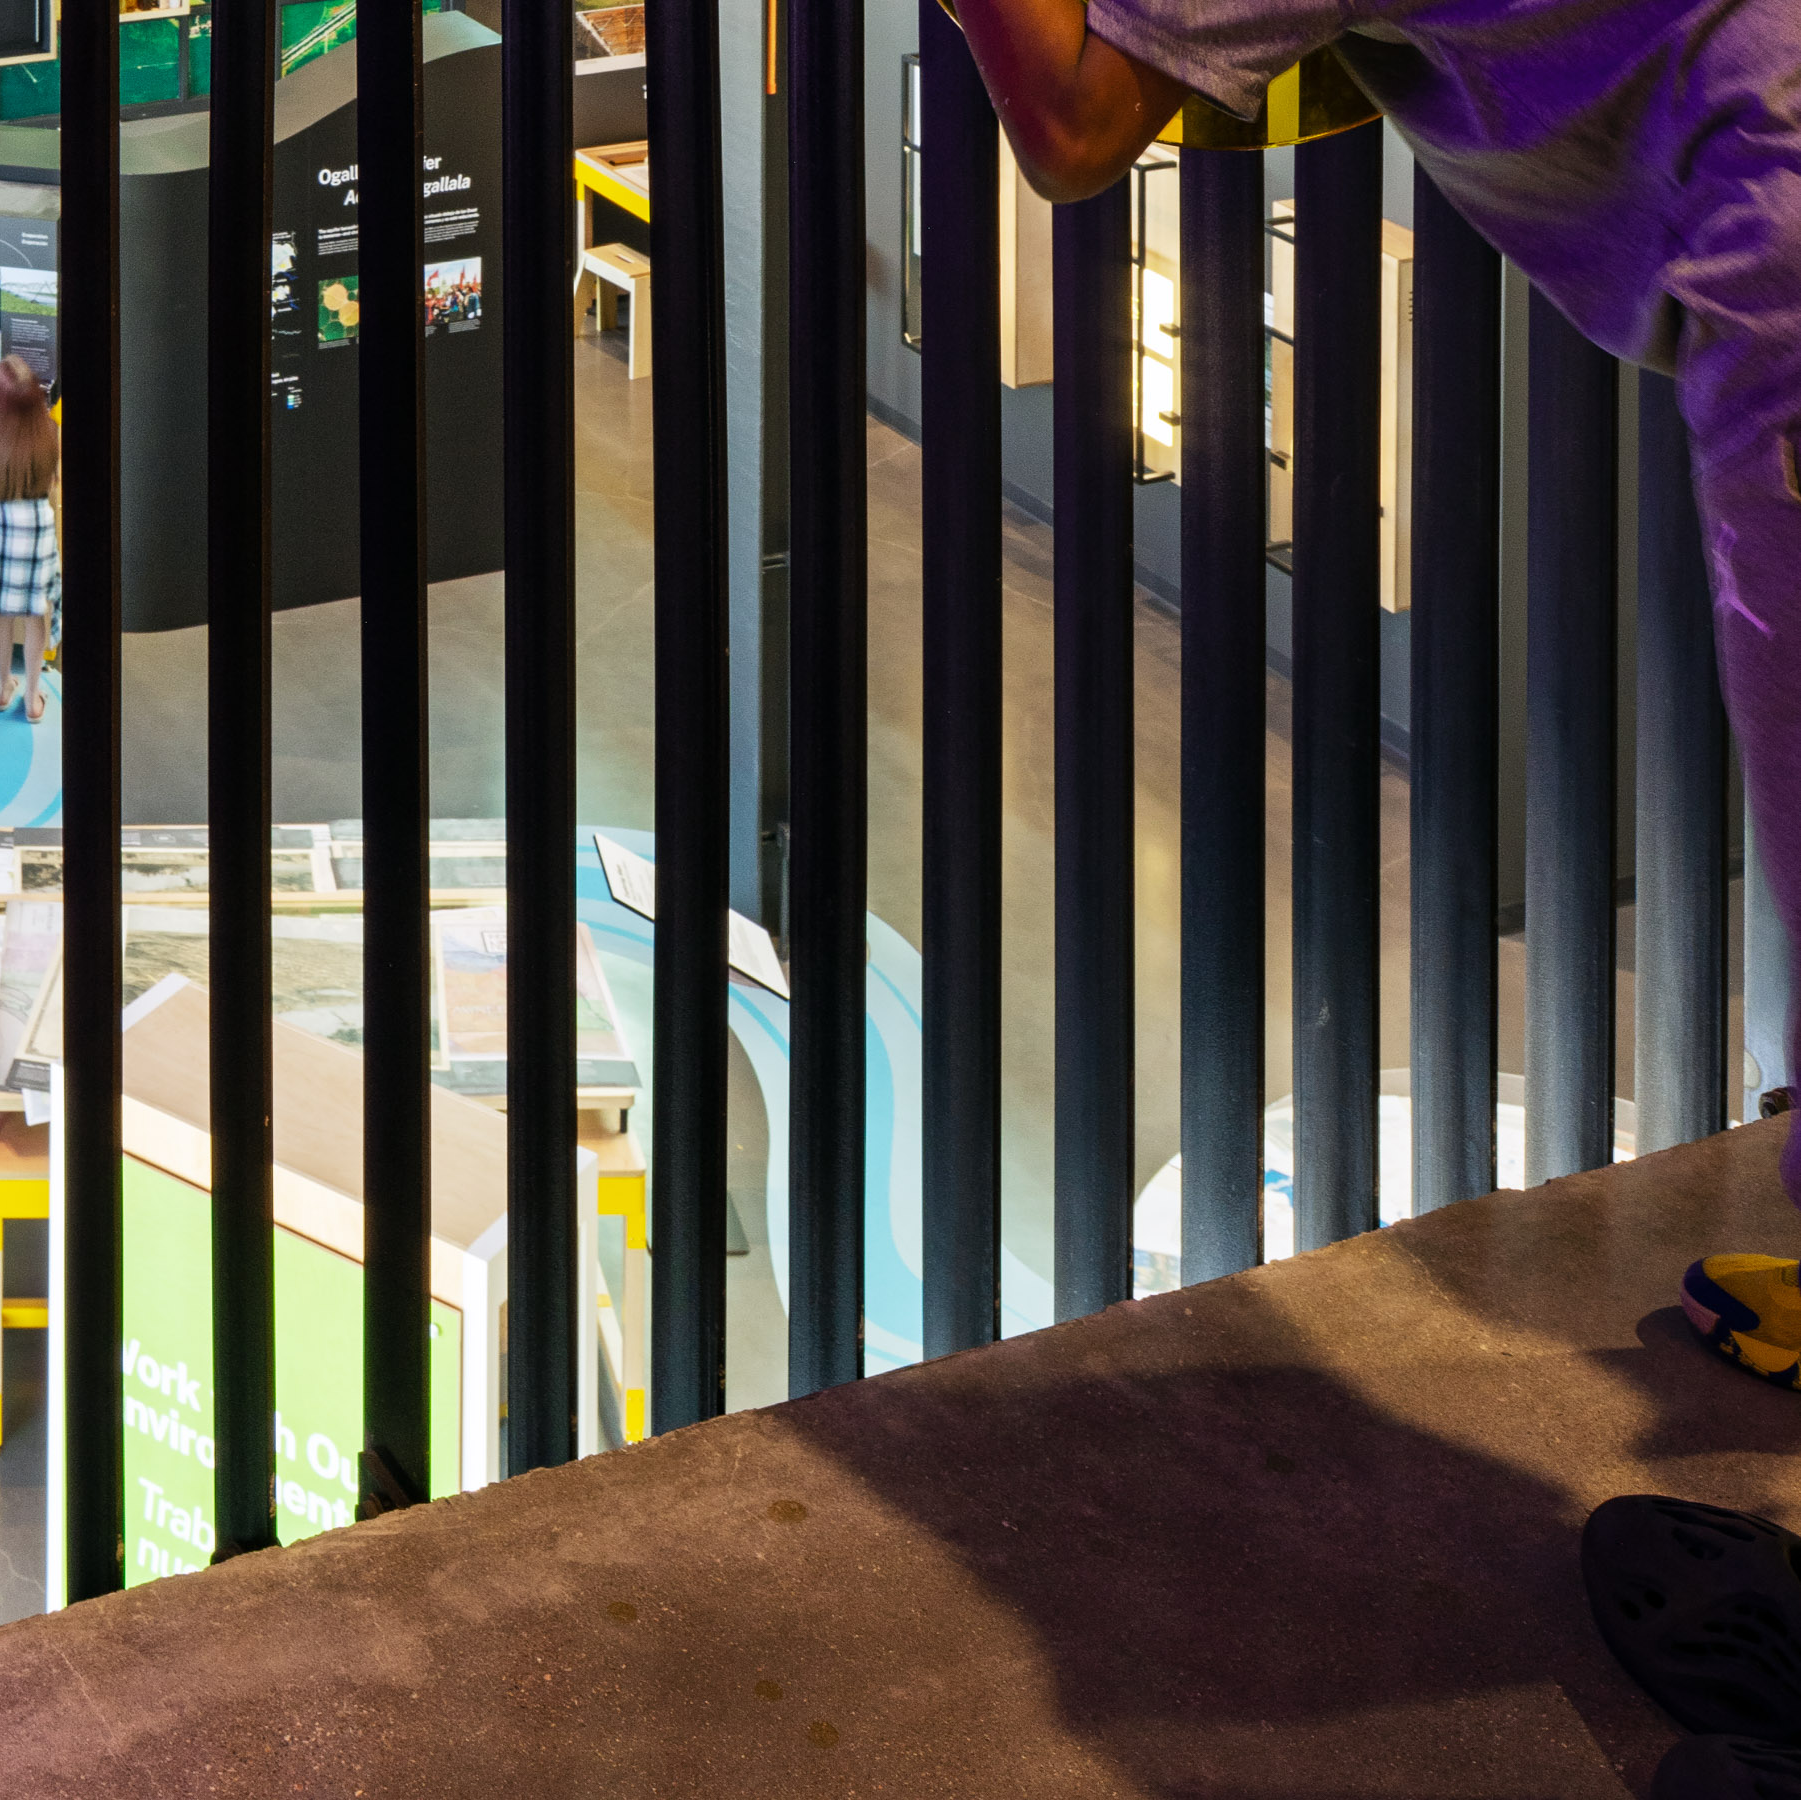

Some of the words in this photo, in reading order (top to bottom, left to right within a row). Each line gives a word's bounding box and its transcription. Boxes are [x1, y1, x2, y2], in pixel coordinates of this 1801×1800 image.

[317, 163, 359, 187] Ogall
[423, 174, 472, 198] gallala
[305, 1432, 359, 1494] Ou
